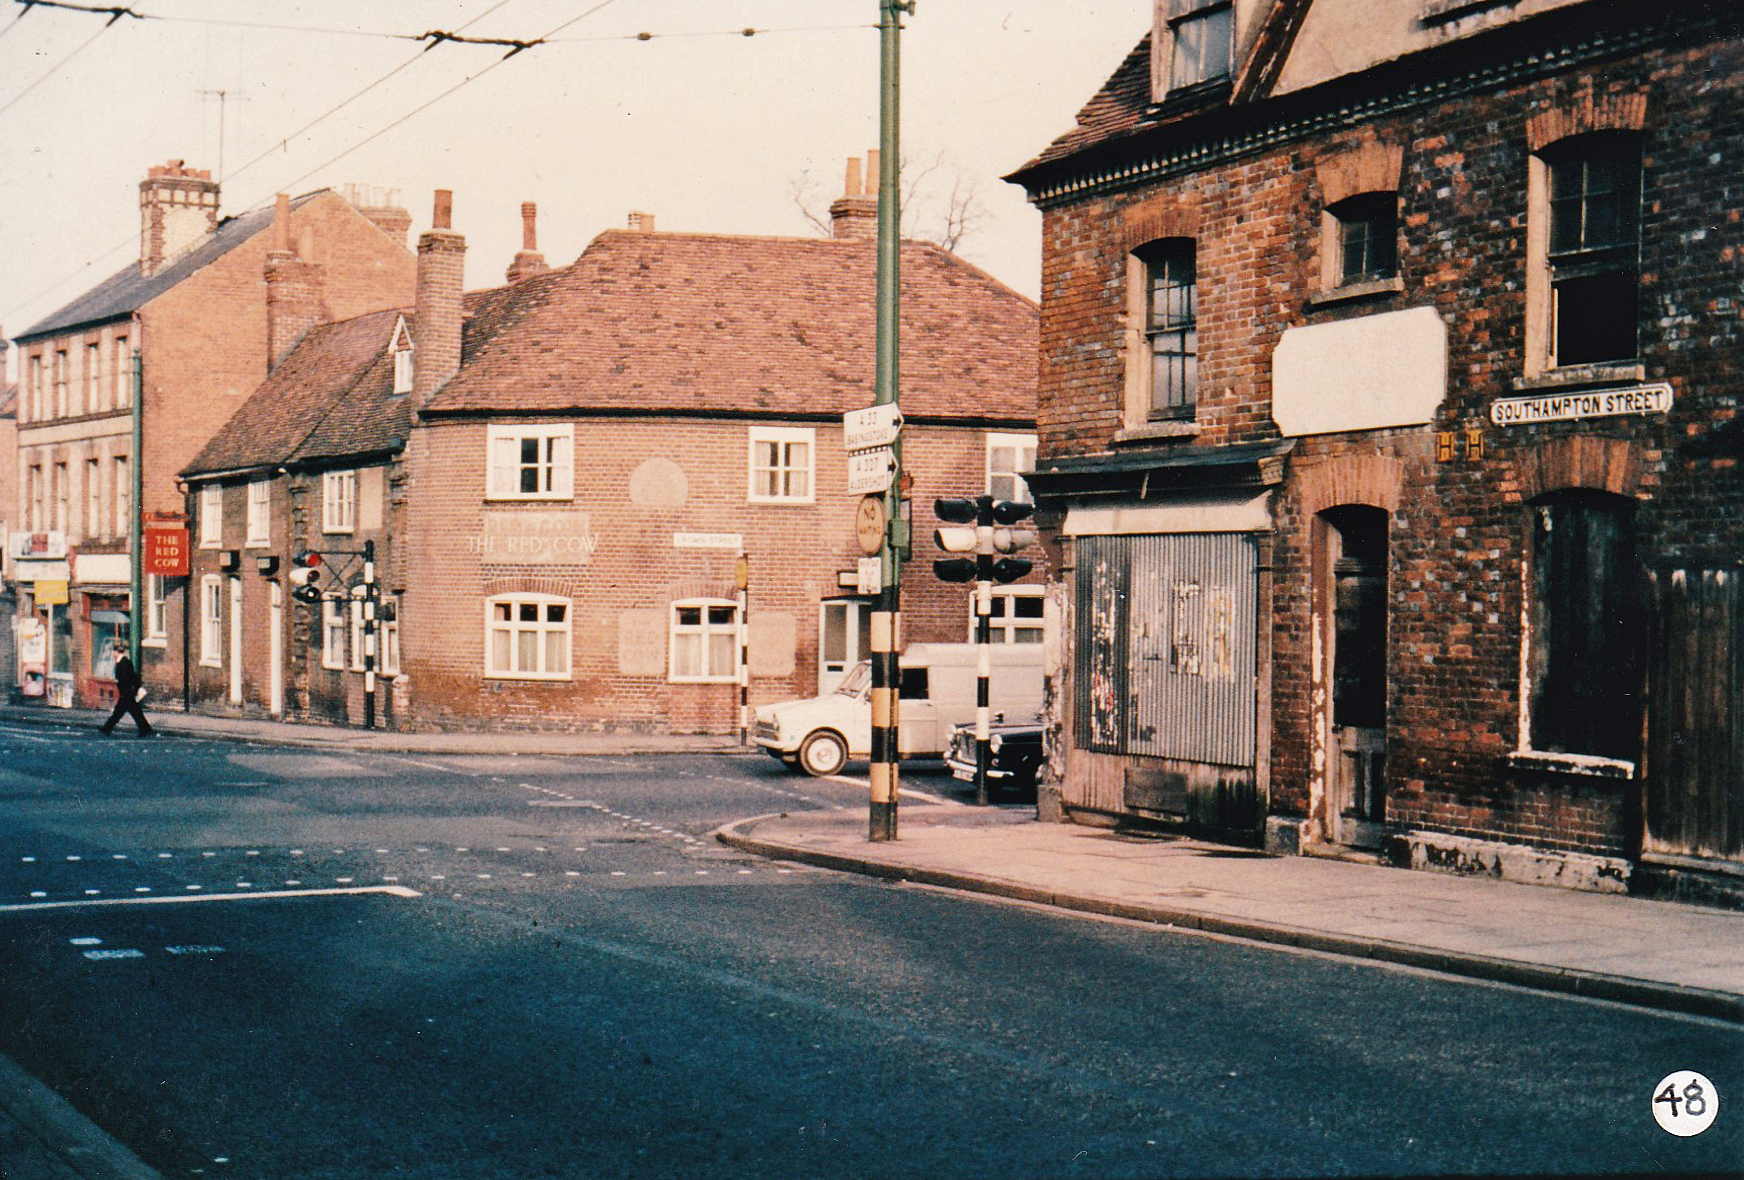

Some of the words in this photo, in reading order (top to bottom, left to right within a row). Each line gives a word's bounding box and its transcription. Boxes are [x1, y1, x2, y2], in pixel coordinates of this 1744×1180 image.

[1496, 395, 1601, 421] SOUTHAMPTON
[1606, 389, 1664, 412] STREET
[863, 505, 876, 520] NO
[155, 535, 179, 545] THE
[466, 536, 497, 553] THE
[507, 536, 543, 553] RED
[553, 533, 599, 553] COW
[155, 546, 179, 556] RED
[154, 558, 180, 568] COW
